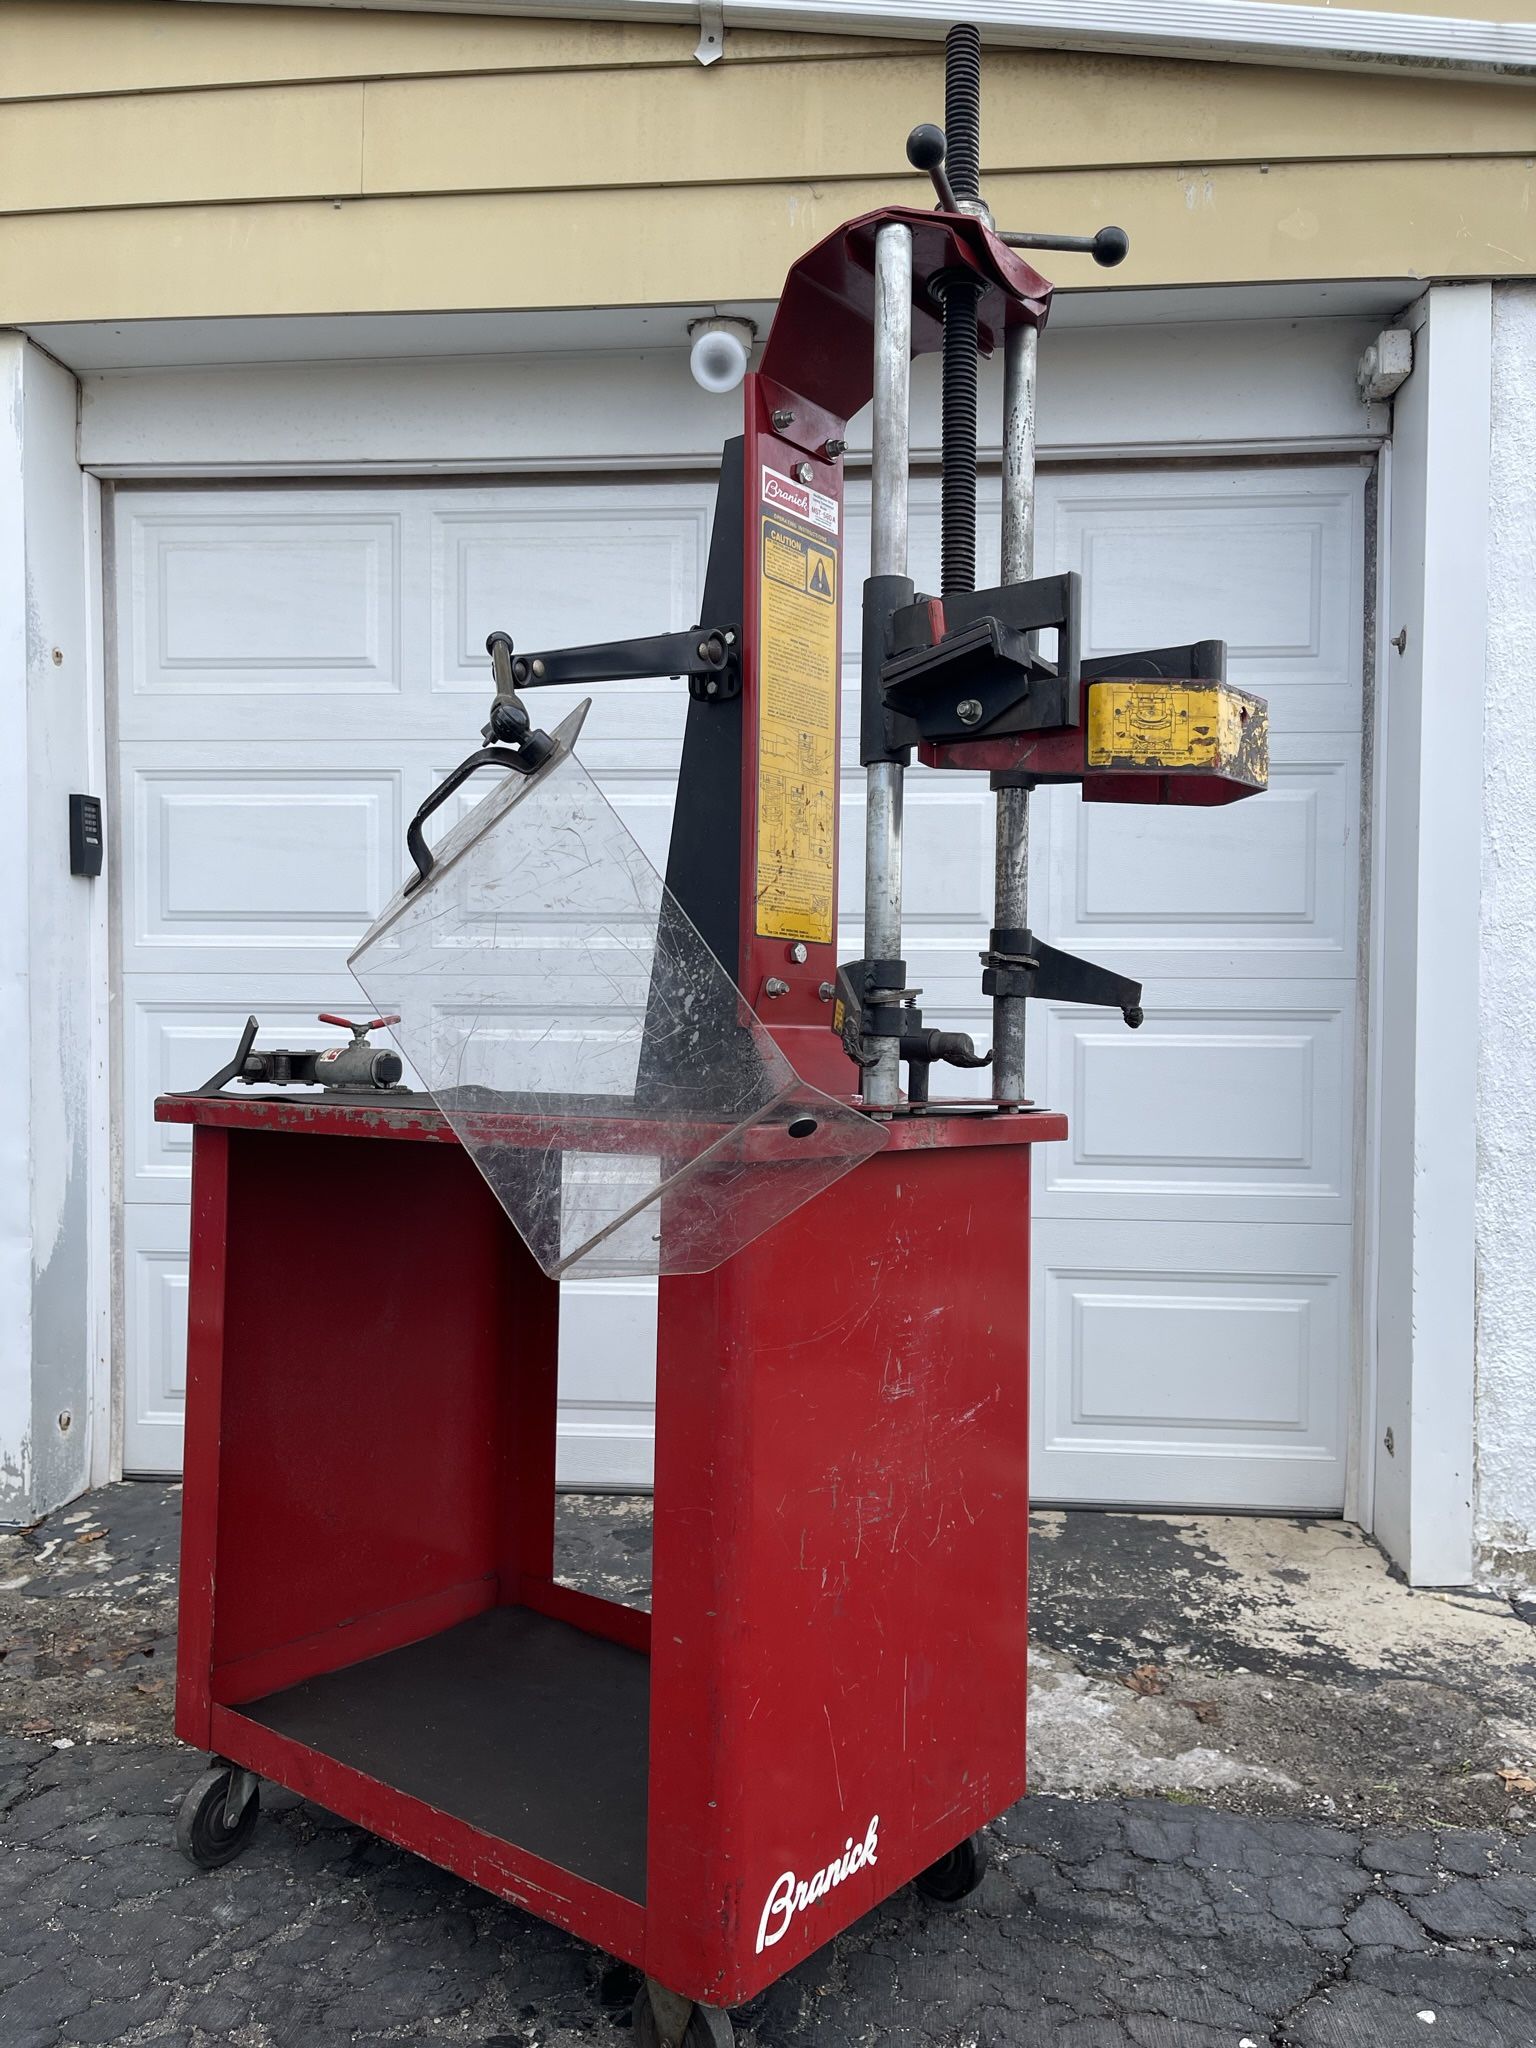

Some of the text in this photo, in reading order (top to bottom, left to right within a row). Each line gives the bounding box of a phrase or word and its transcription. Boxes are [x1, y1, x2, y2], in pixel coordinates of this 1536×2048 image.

[765, 480, 808, 511] Branick
[770, 530, 802, 551] CAUTION
[755, 1815, 879, 1955] Branick
